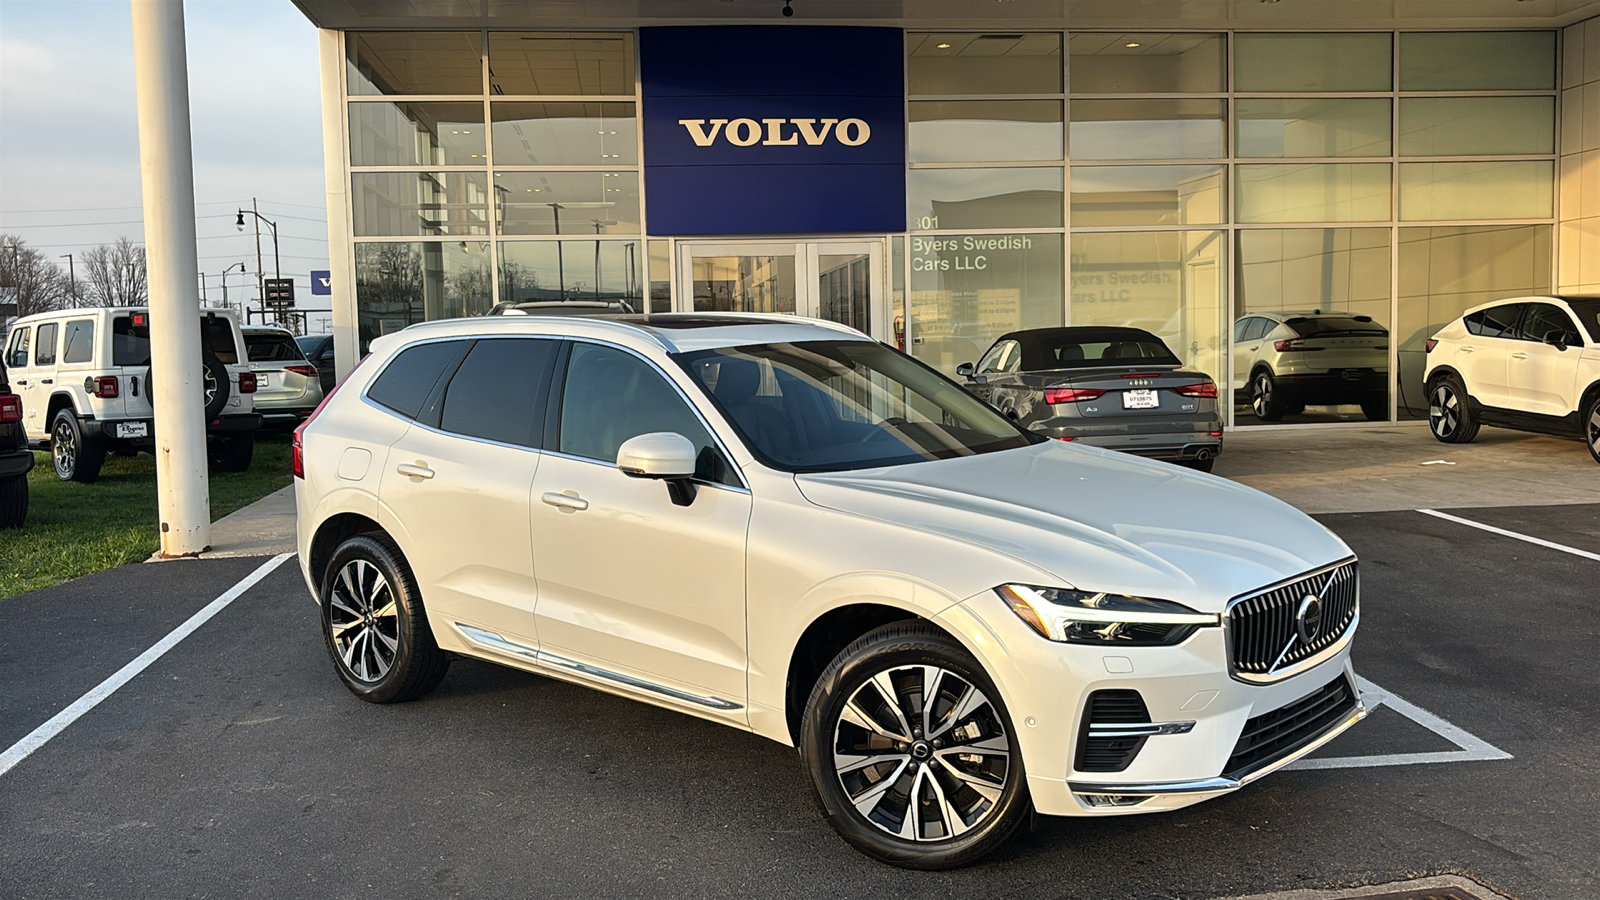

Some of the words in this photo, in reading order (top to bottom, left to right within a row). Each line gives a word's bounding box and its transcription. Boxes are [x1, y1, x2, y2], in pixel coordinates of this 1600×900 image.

[679, 118, 871, 147] VOLVO
[913, 237, 958, 255] Byers
[963, 235, 1032, 251] Swedish
[913, 257, 950, 271] Cars
[955, 255, 987, 270] LLC
